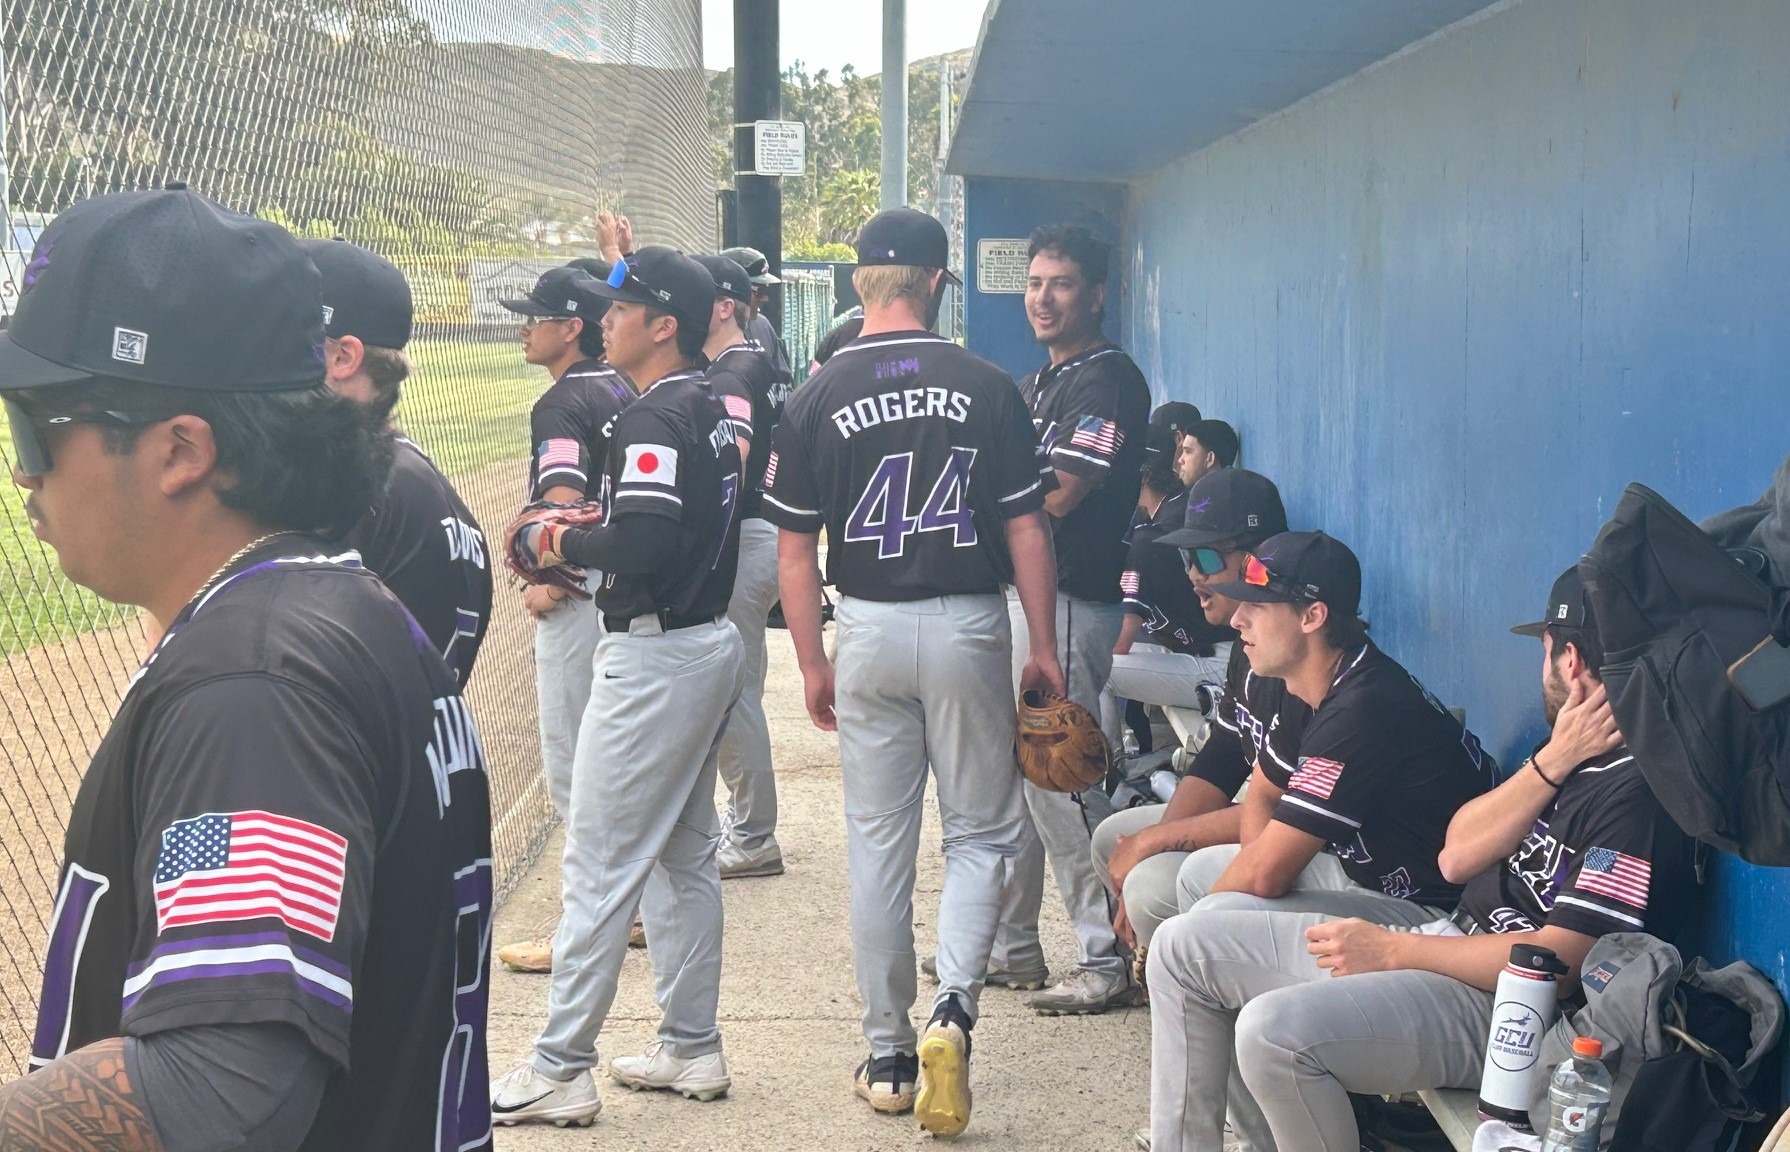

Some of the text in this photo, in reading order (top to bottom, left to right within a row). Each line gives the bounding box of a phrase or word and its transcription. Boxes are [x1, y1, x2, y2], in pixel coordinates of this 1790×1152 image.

[831, 387, 972, 439] ROGERS
[844, 446, 978, 560] 44
[1494, 1026, 1536, 1048] GCU
